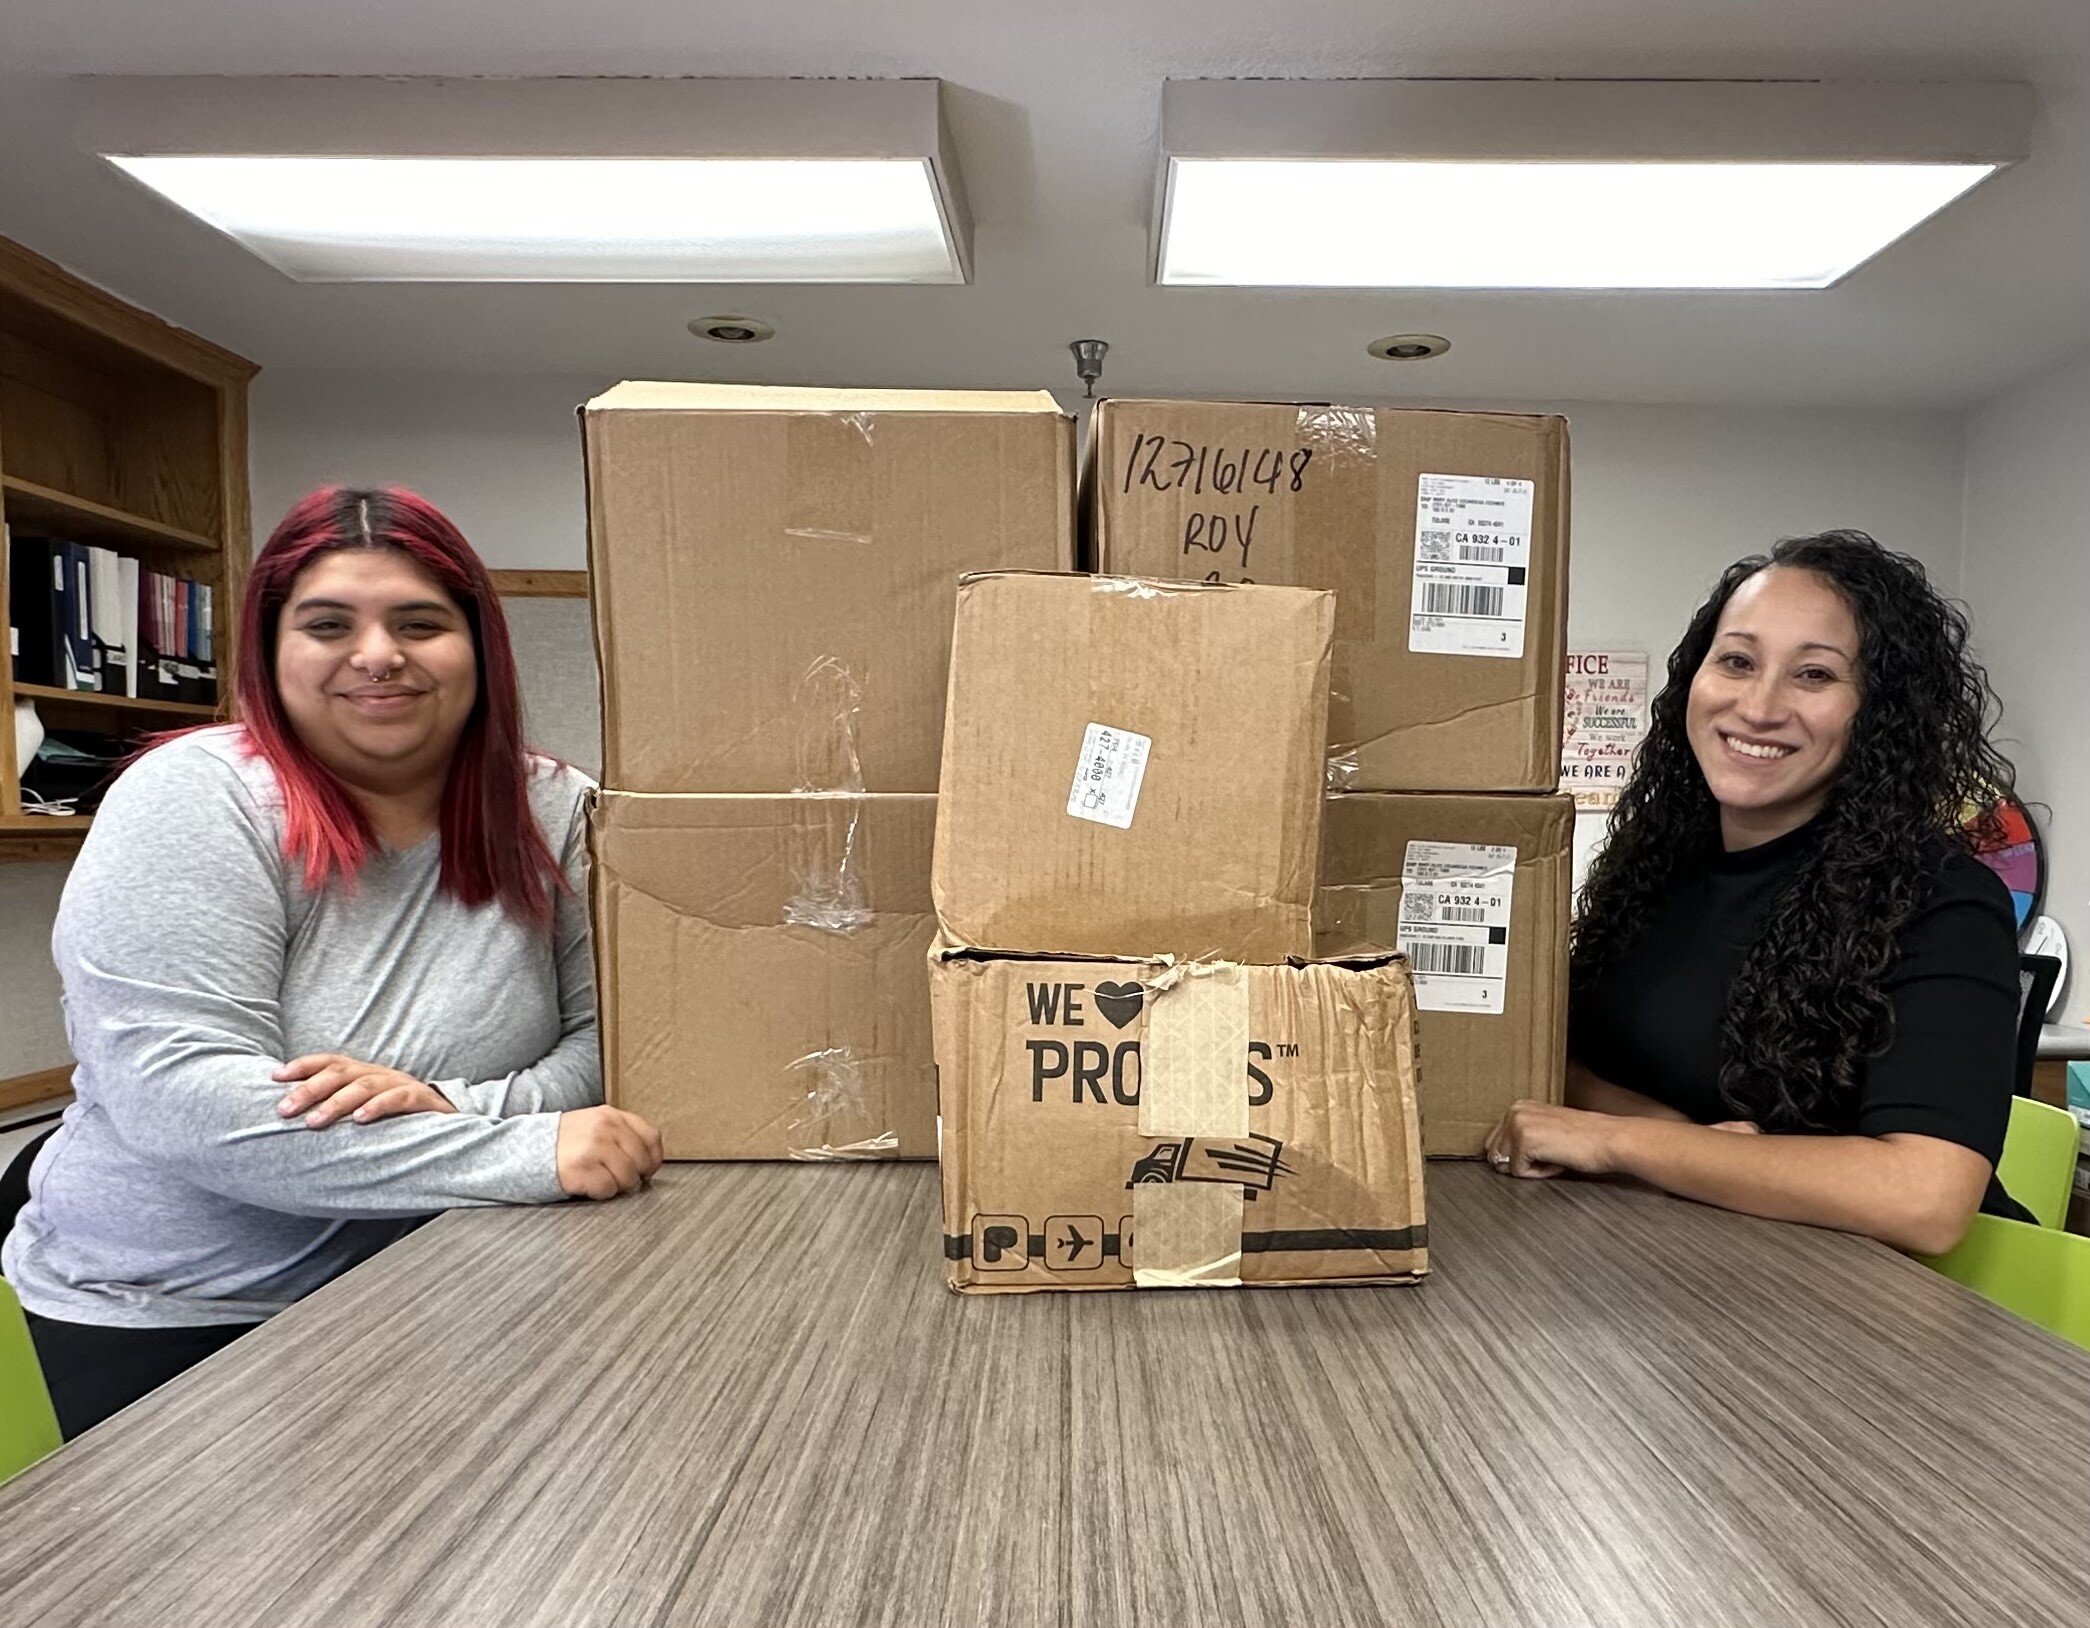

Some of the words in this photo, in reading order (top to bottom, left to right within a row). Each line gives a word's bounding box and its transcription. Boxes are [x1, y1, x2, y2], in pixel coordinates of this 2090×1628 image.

[1183, 505, 1259, 568] ROY
[1455, 533, 1469, 544] CA
[1472, 534, 1489, 545] 932
[1501, 632, 1506, 641] 3
[1588, 679, 1605, 689] WE
[1608, 679, 1631, 690] ARE
[1584, 688, 1634, 703] Friends
[1595, 705, 1608, 715] We
[1611, 707, 1626, 715] are
[1582, 716, 1637, 729] SUCCESSFUL
[1577, 742, 1631, 761] Together
[1561, 765, 1579, 777] WE
[1584, 765, 1611, 779] ARE
[1616, 765, 1625, 780] A
[1438, 894, 1450, 904] CA
[1454, 895, 1471, 906] 932
[1482, 989, 1487, 998] 3
[1026, 983, 1085, 1026] WE
[1026, 1039, 1274, 1106] PROS
